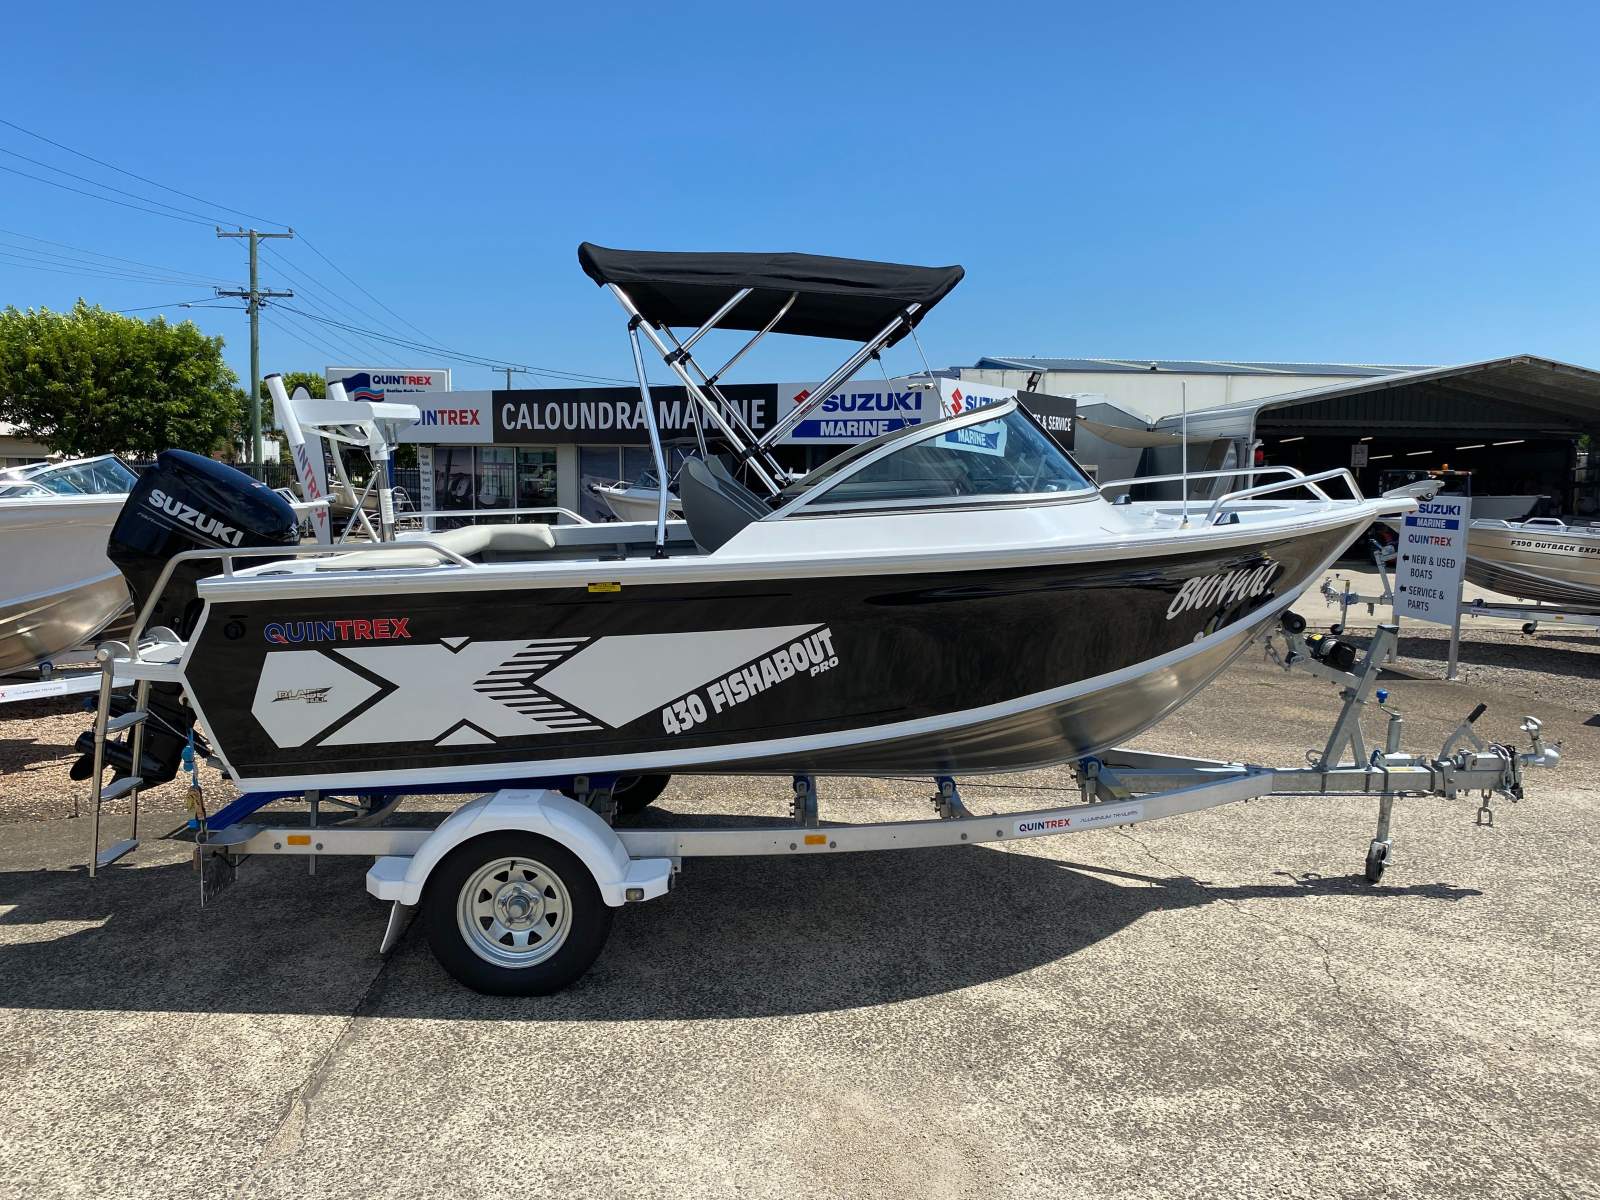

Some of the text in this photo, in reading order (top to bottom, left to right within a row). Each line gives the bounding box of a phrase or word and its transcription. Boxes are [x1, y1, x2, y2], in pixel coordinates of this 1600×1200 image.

[372, 375, 432, 386] QUINTREX
[821, 392, 922, 412] SUZUKI
[413, 409, 480, 426] INTREX
[501, 400, 765, 430] CALOUNDRA MARINE
[820, 420, 889, 437] MARINE
[1048, 415, 1071, 432] SERVICE
[957, 429, 987, 447] MARINE
[149, 488, 245, 547] SUZUKI
[1419, 504, 1461, 515] SUZUKI
[1416, 518, 1446, 529] MARINE
[1408, 534, 1452, 546] QUINTREX
[1535, 542, 1576, 552] OUTBACK
[1411, 554, 1456, 569] NEW & USED
[1410, 568, 1433, 580] BOATS
[1408, 586, 1444, 600] SERVICE &
[1407, 599, 1429, 611] PARTS
[264, 617, 412, 644] QUINTREX
[810, 656, 839, 678] PRO
[662, 627, 836, 735] 430 FISHABOUT
[1019, 818, 1071, 832] QUINTREX
